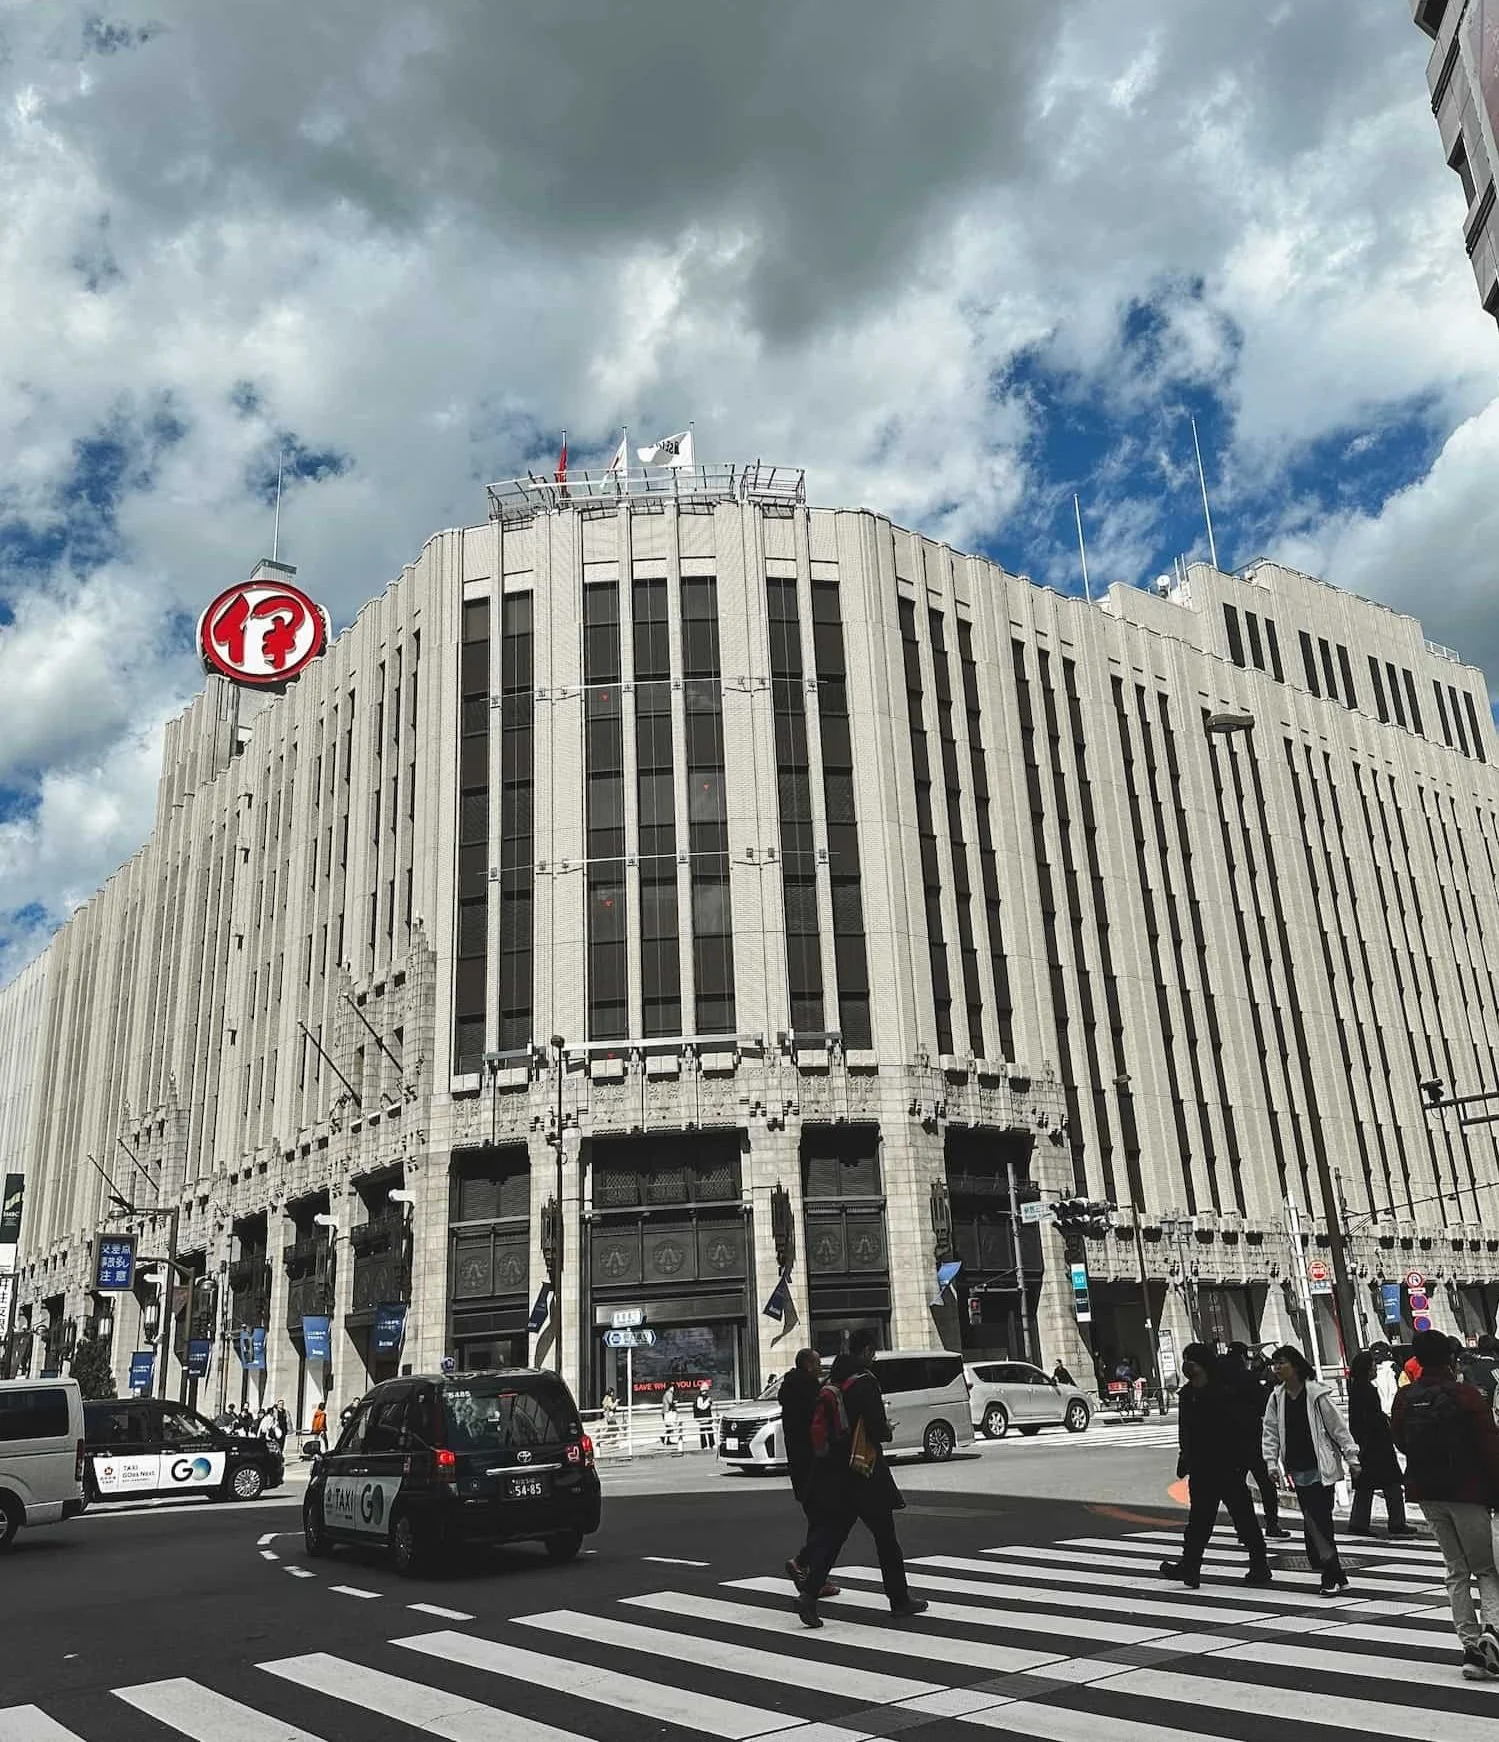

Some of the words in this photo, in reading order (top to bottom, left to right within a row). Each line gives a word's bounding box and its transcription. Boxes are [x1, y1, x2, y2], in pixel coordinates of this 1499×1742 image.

[213, 592, 306, 670] 伊
[102, 1244, 131, 1255] 交差点
[101, 1256, 130, 1268] 事故多し
[100, 1270, 127, 1282] 注意
[633, 1383, 653, 1392] SAVE
[676, 1380, 692, 1388] YOU
[123, 1464, 139, 1472] TAXI
[171, 1457, 212, 1482] GO
[335, 1487, 354, 1513] TAXI
[361, 1483, 384, 1526] GO
